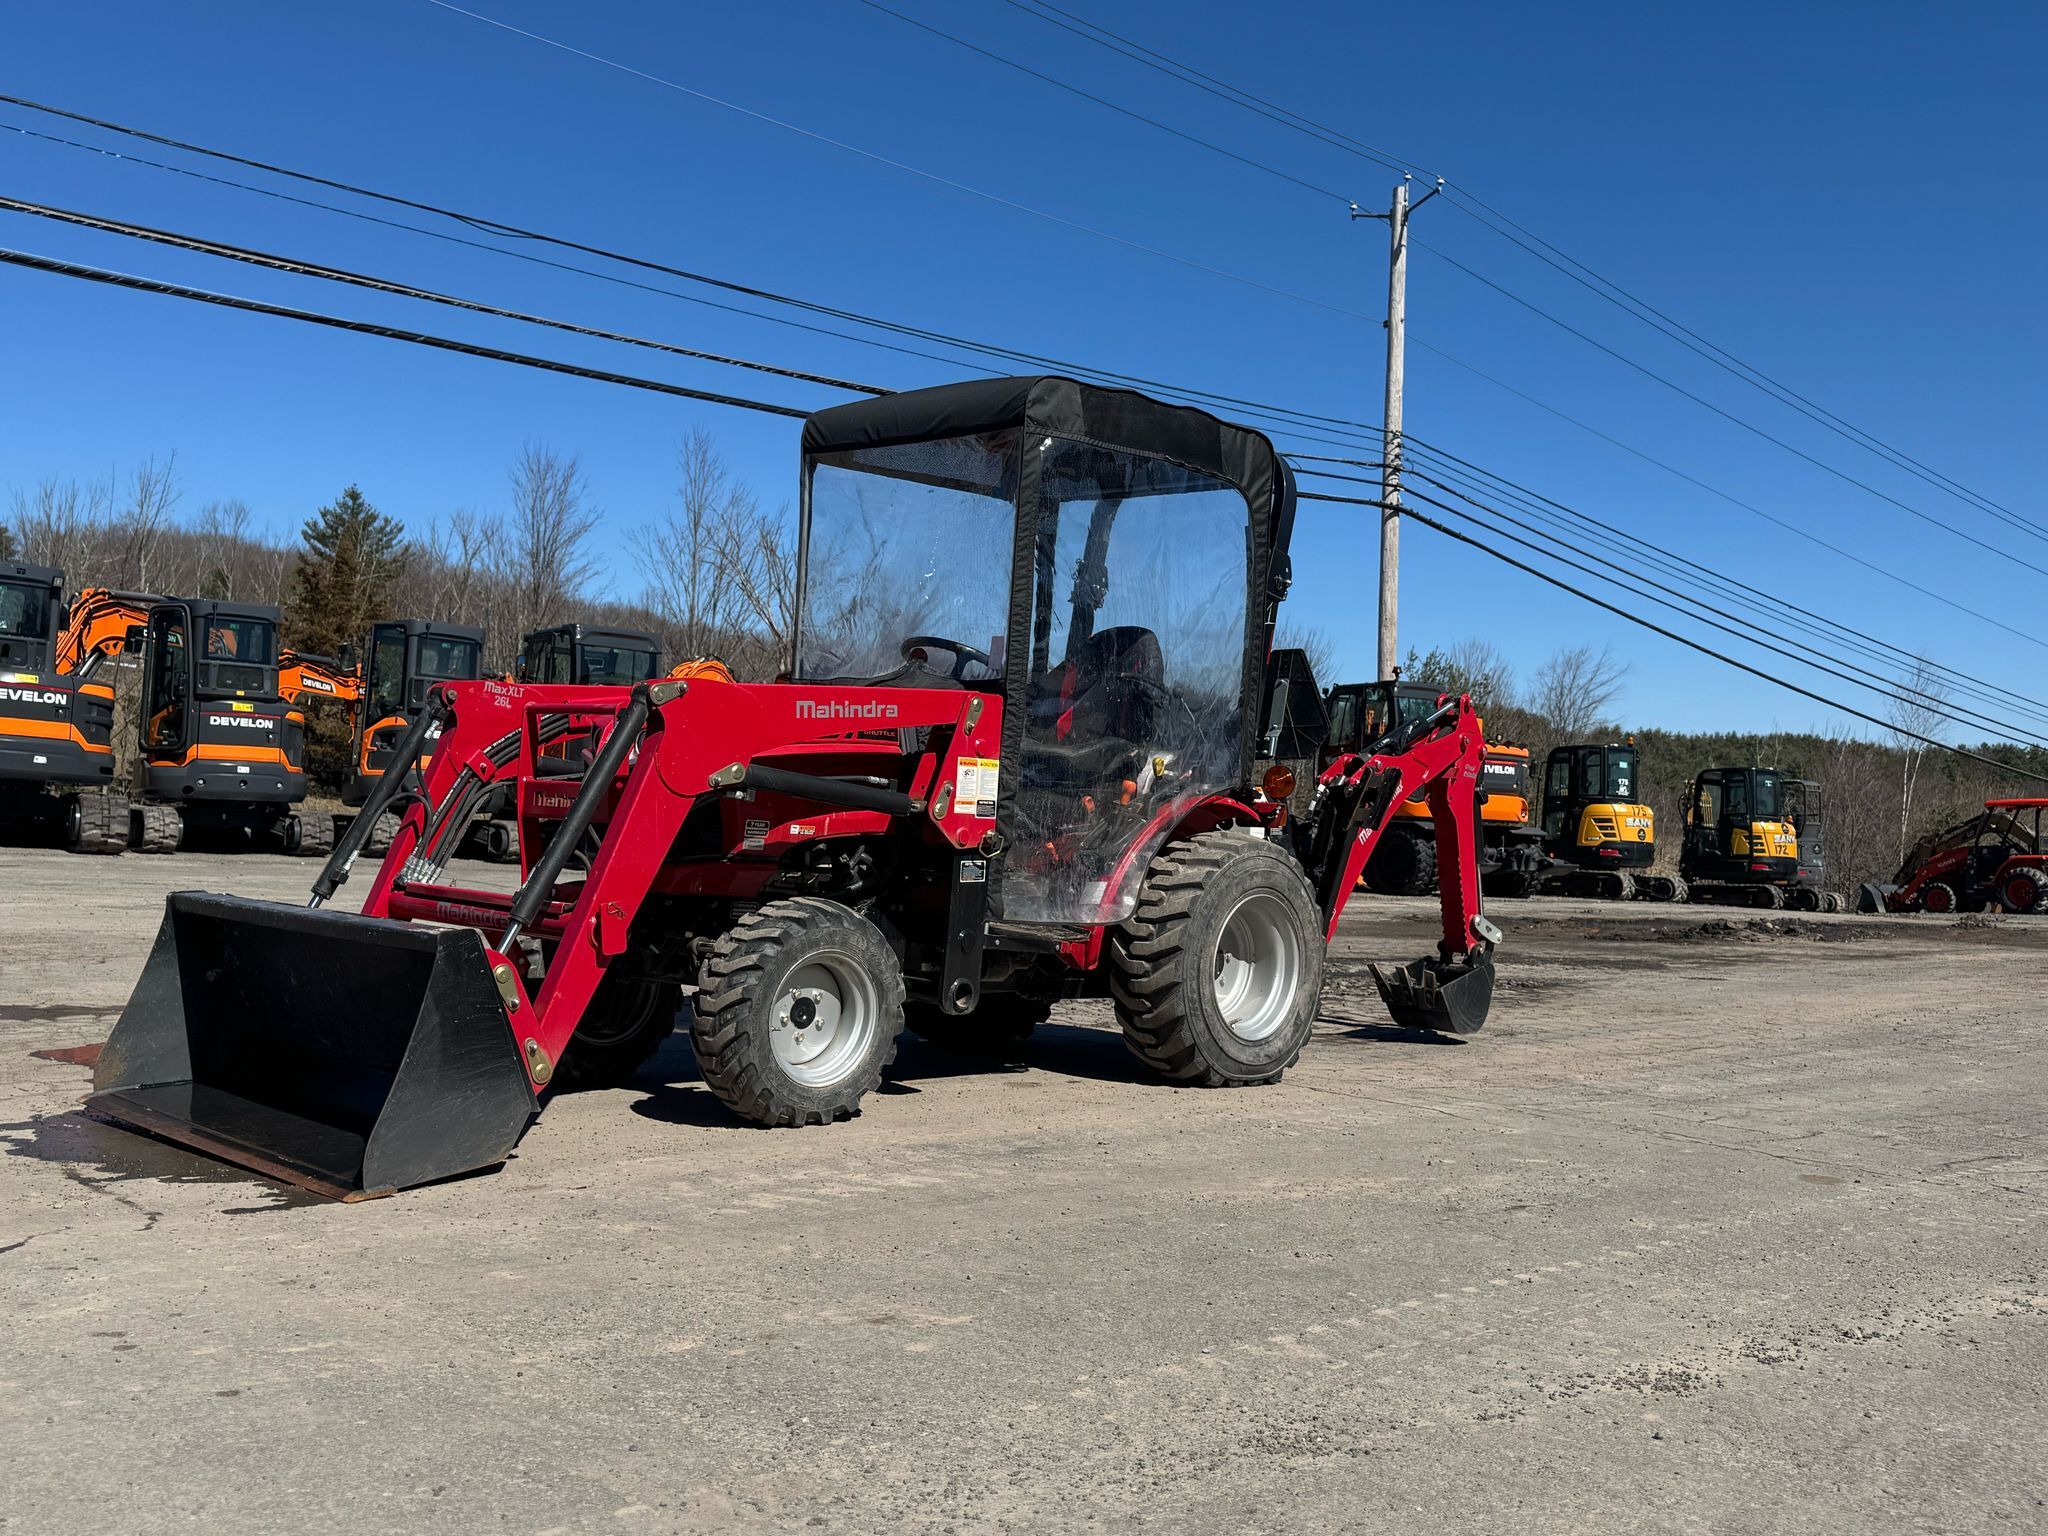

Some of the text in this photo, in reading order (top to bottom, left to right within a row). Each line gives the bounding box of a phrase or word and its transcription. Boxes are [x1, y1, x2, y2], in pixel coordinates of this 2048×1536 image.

[302, 677, 332, 692] DEVELON
[0, 687, 67, 705] EVELON
[493, 695, 512, 709] 26L
[795, 700, 899, 719] Mahindra
[209, 715, 274, 729] DEVELON
[1484, 764, 1516, 776] EVELON
[1632, 806, 1647, 817] 175
[1626, 817, 1651, 828] SANY
[1774, 834, 1795, 844] SANY
[1774, 844, 1789, 856] 172
